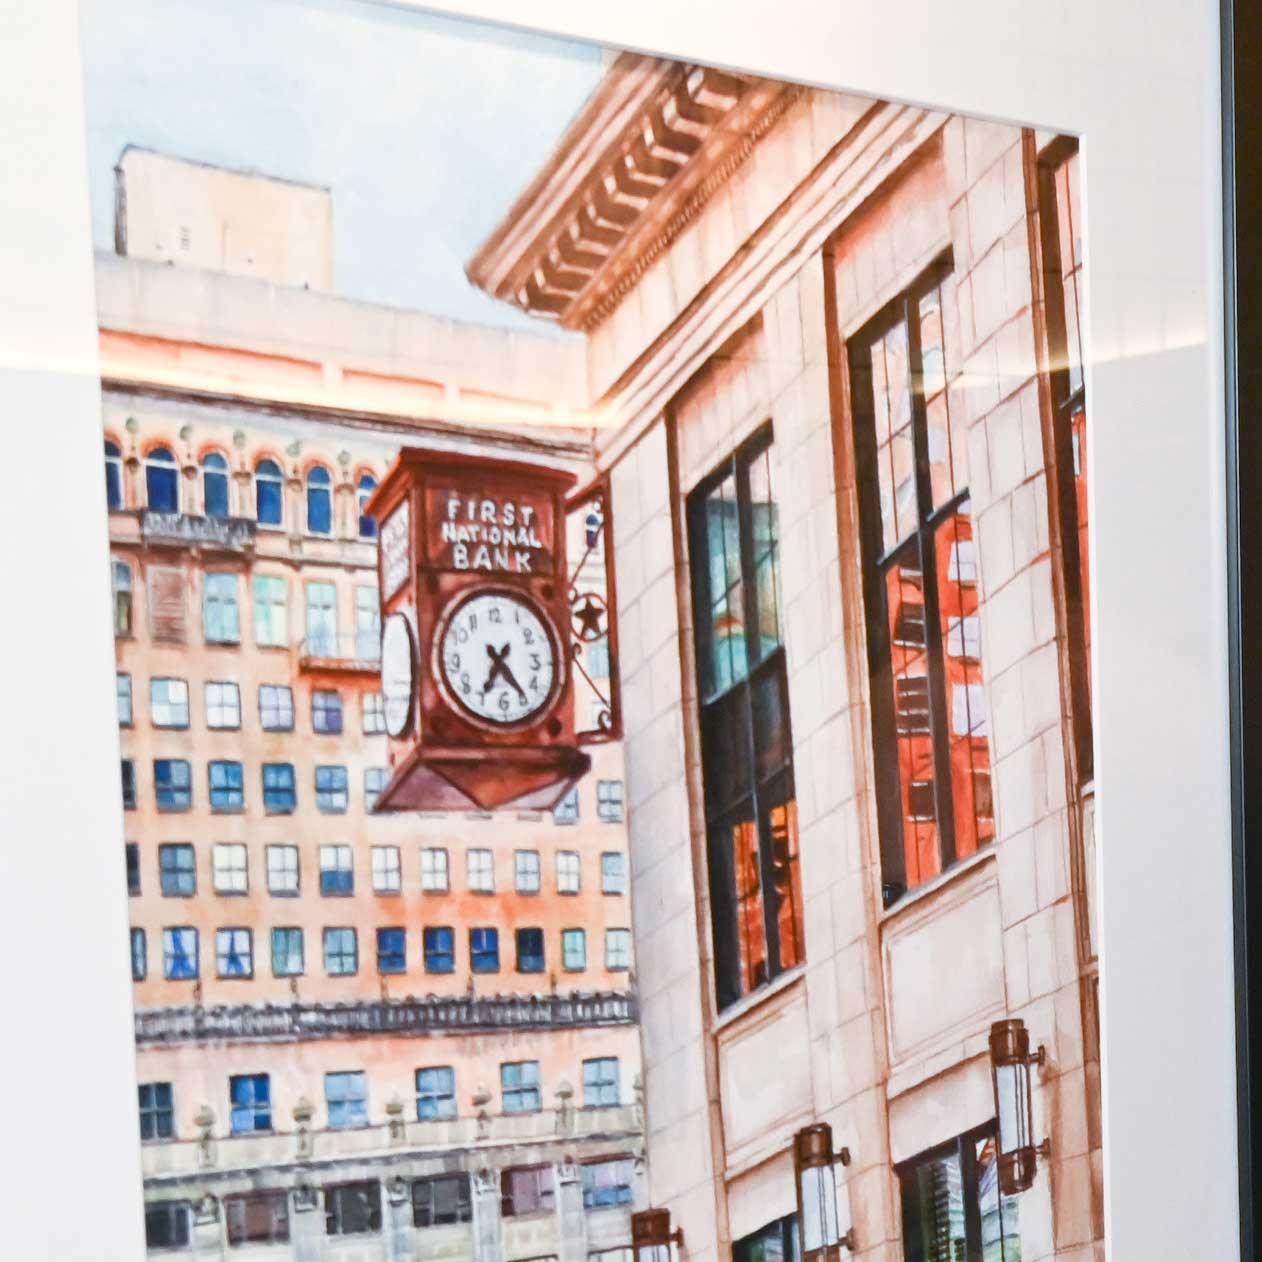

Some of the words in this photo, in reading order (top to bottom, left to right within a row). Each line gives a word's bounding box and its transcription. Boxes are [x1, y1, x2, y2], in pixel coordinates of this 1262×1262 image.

[447, 498, 534, 526] FIRST
[441, 521, 543, 549] NATIONAL
[453, 543, 533, 573] BANK
[529, 652, 542, 671] 3
[498, 691, 510, 711] 6
